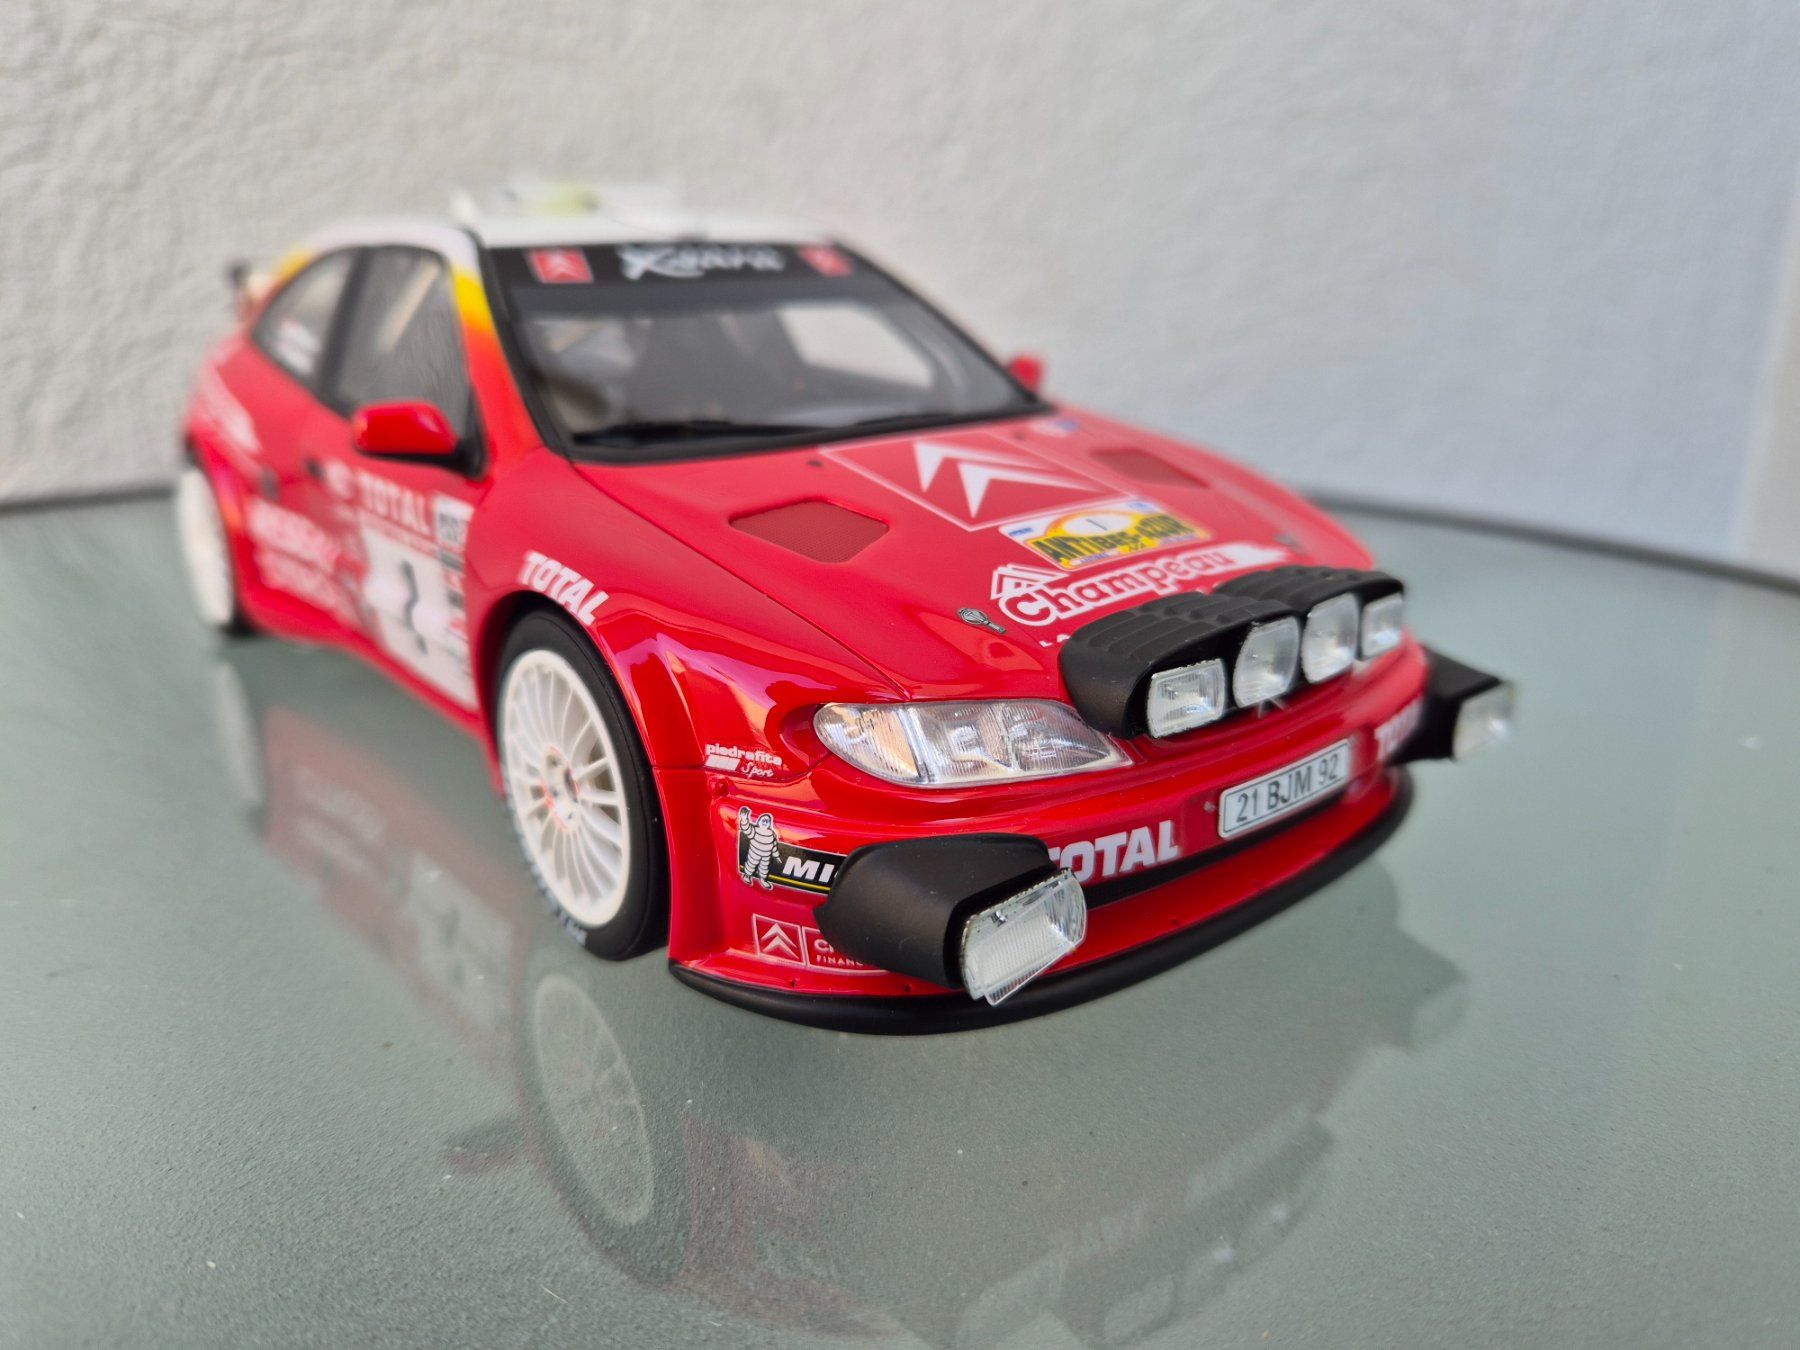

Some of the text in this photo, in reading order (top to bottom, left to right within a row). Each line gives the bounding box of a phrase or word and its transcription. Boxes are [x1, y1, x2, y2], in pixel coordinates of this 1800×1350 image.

[520, 551, 609, 626] TOTAL
[1000, 548, 1236, 622] Champeau
[741, 761, 774, 778] Sport
[1235, 754, 1341, 825] 21 BJM 92
